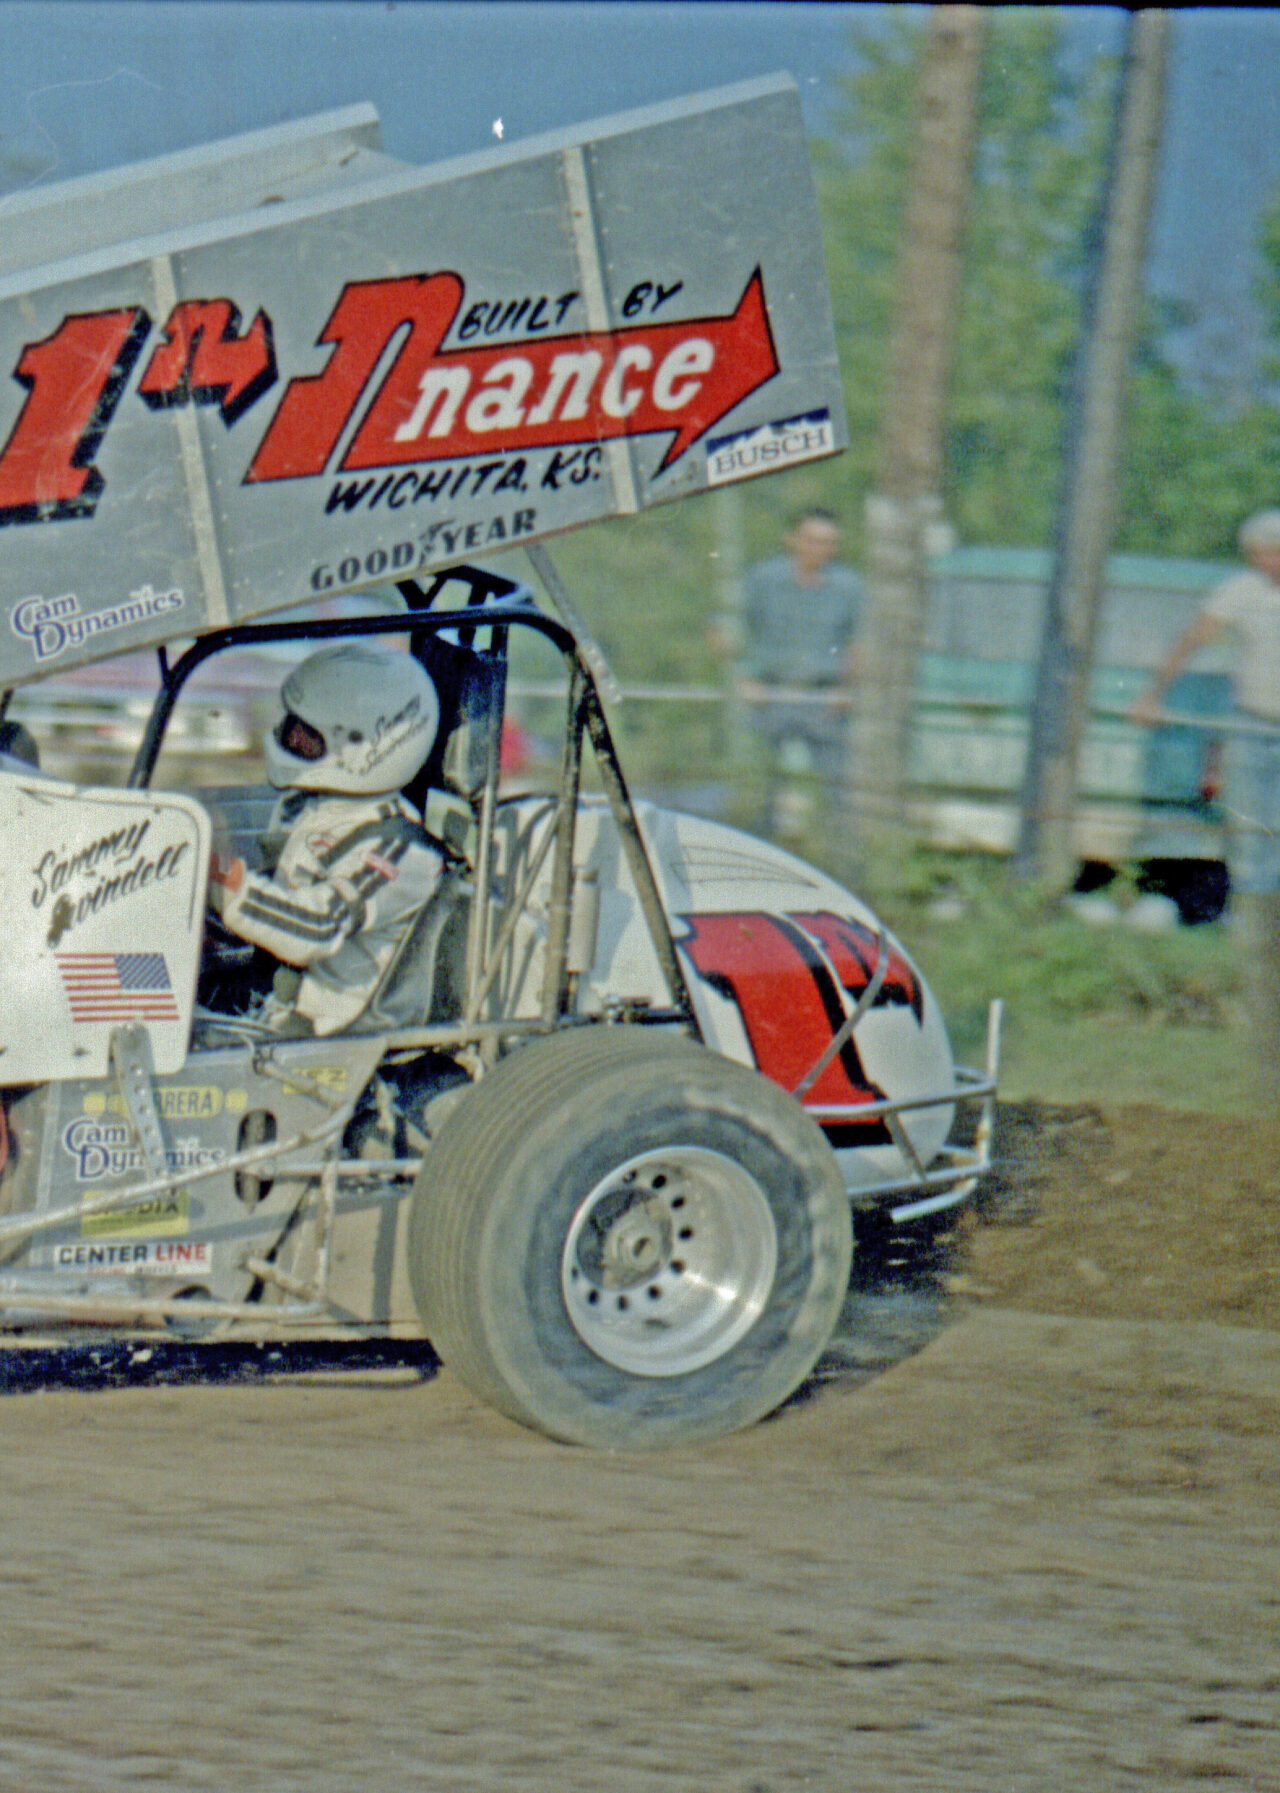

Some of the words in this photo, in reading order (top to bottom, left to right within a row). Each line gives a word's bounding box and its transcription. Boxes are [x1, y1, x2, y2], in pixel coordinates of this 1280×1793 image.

[458, 290, 580, 341] BUILT
[623, 279, 683, 318] BY
[394, 337, 716, 443] nance
[715, 426, 827, 474] BUSCH
[311, 508, 536, 591] GOODYEAR
[13, 597, 76, 636] Cam
[34, 590, 183, 657] Dynamics
[32, 819, 150, 909] Sammy
[66, 1119, 126, 1154] Cam
[80, 1144, 223, 1179] Dynmics
[59, 1245, 148, 1263] CENTER
[155, 1242, 207, 1261] LINE
